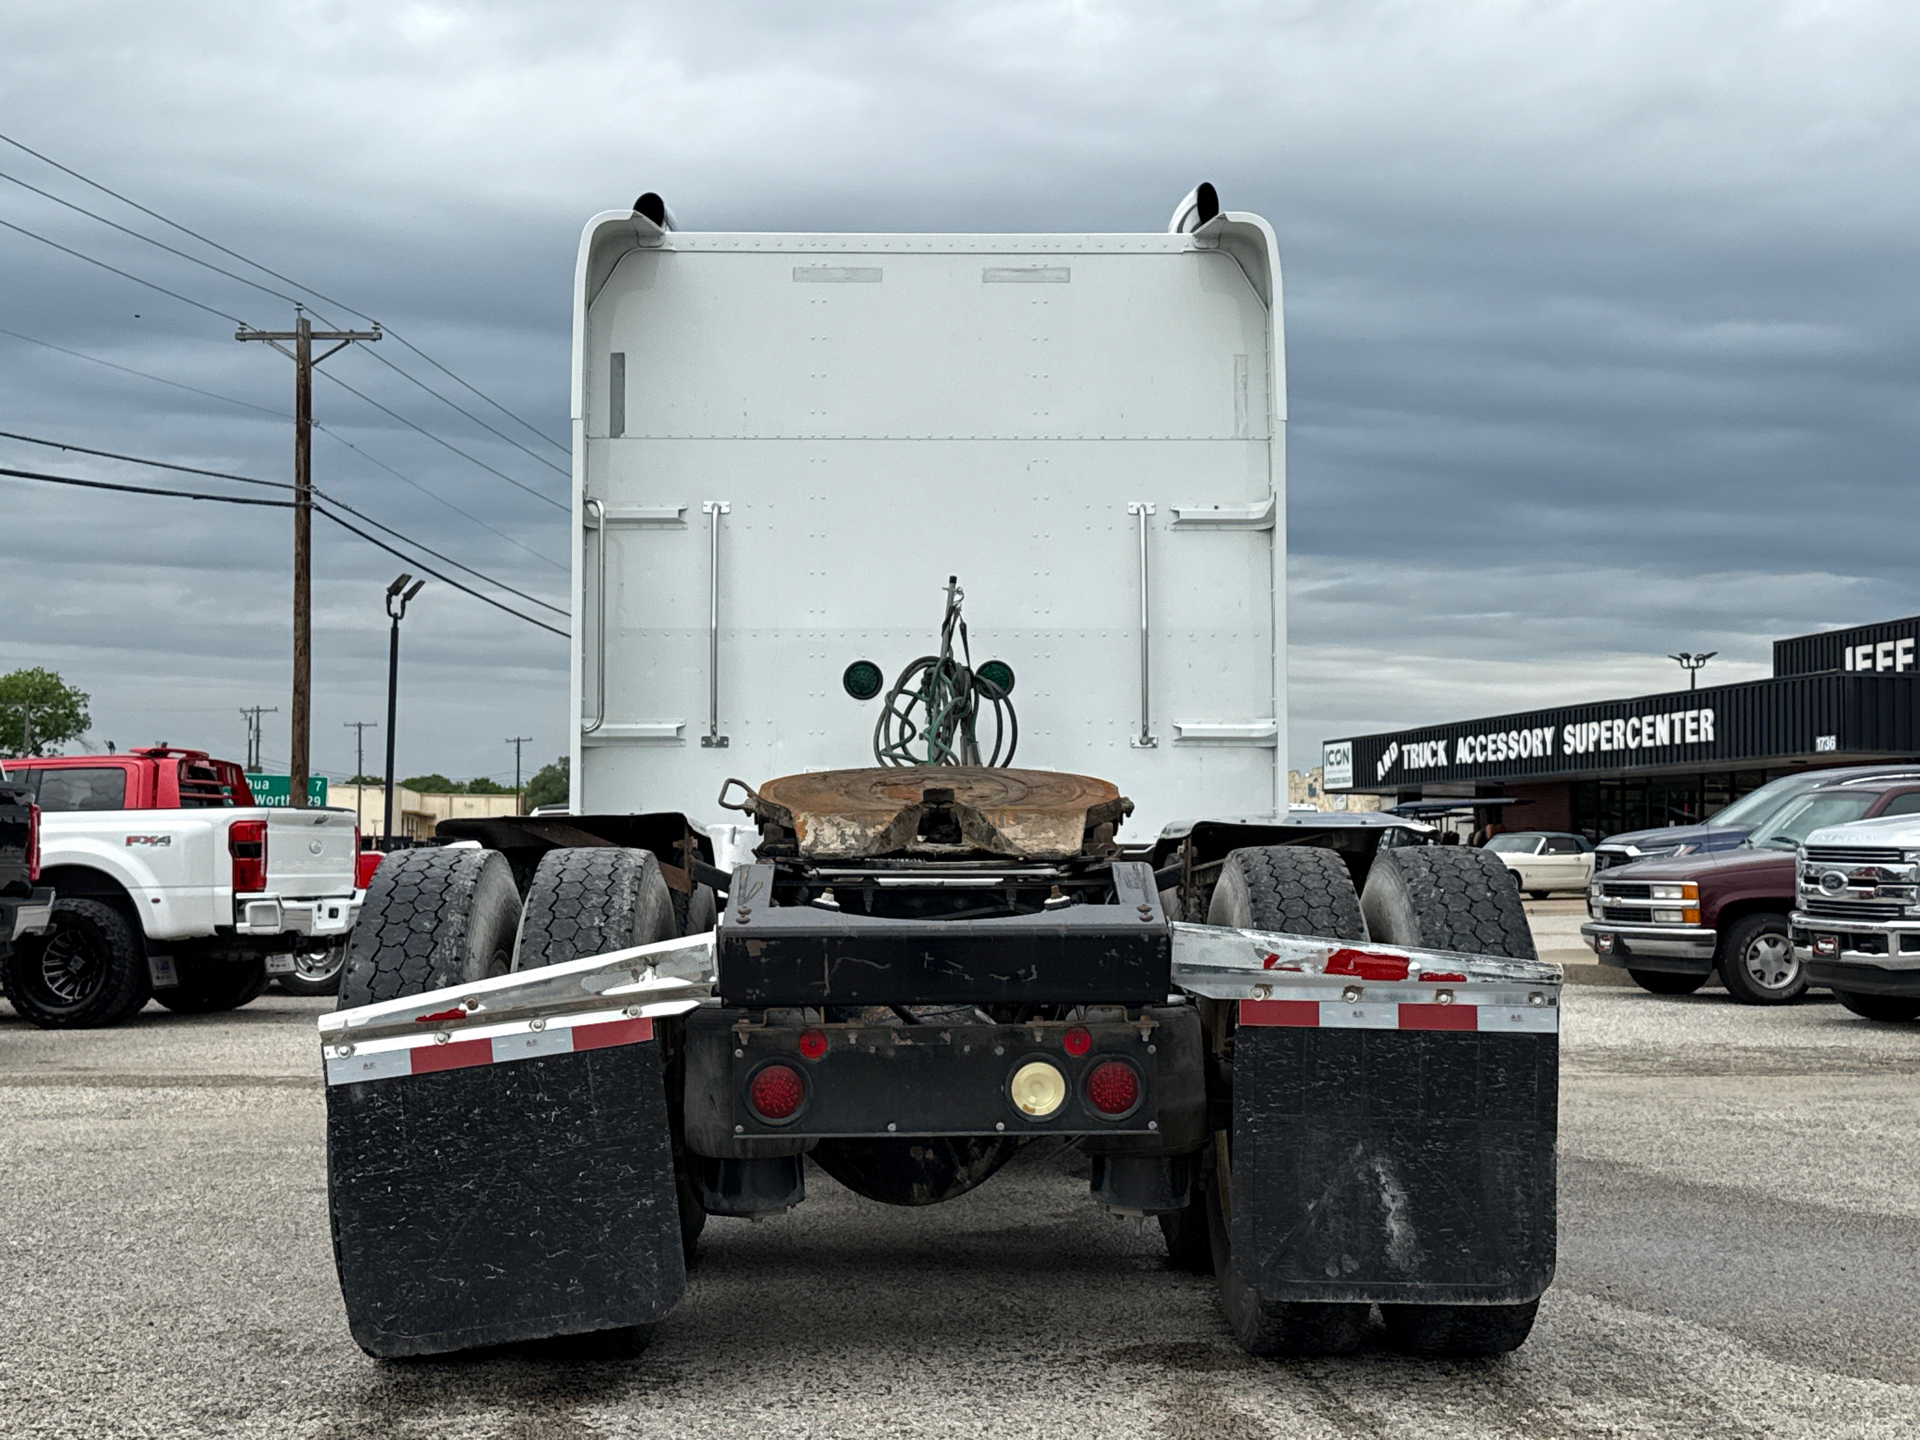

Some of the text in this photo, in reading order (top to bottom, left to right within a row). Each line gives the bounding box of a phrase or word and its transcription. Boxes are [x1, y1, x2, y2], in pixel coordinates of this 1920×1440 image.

[1377, 708, 1715, 782] AND TRUCK ACCESSORY SUPERCENTER
[1816, 736, 1836, 752] 1736
[1325, 747, 1350, 767] ICON
[246, 778, 322, 792] hua 7
[307, 795, 321, 807] 29
[125, 835, 171, 846] FX4
